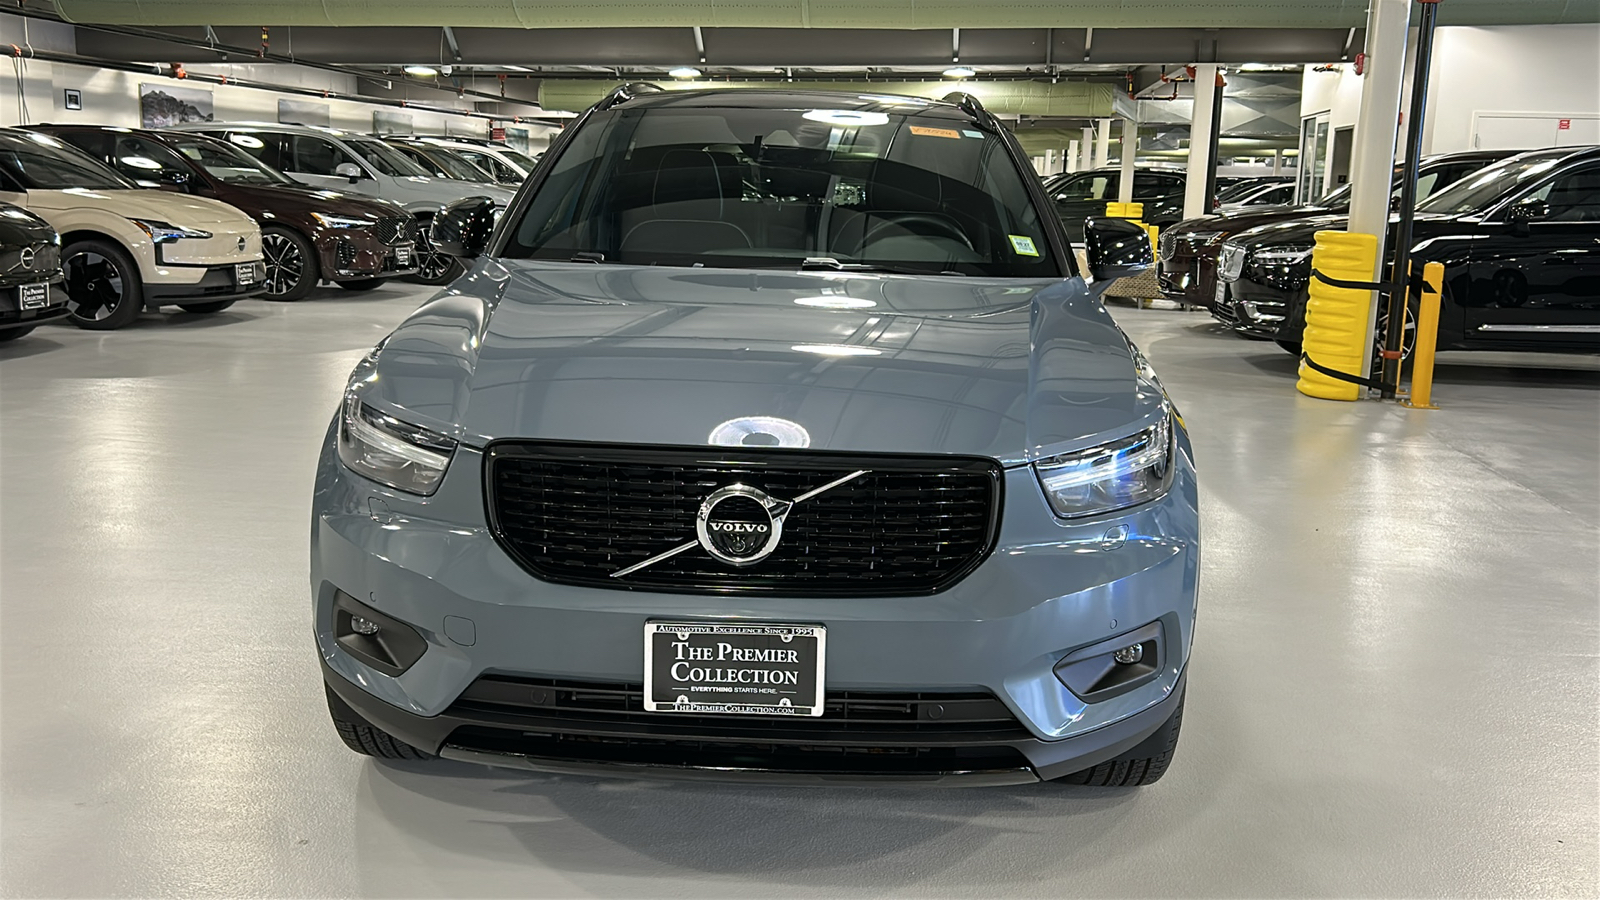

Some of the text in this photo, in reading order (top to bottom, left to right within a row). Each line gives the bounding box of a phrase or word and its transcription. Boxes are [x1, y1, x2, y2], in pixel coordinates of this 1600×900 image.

[709, 522, 768, 532] VOLVO
[658, 625, 813, 636] AUTOMOTIVE EXCELLENCE SINCE 1995
[670, 642, 799, 664] THE PREMIER
[670, 662, 799, 686] COLLECTION
